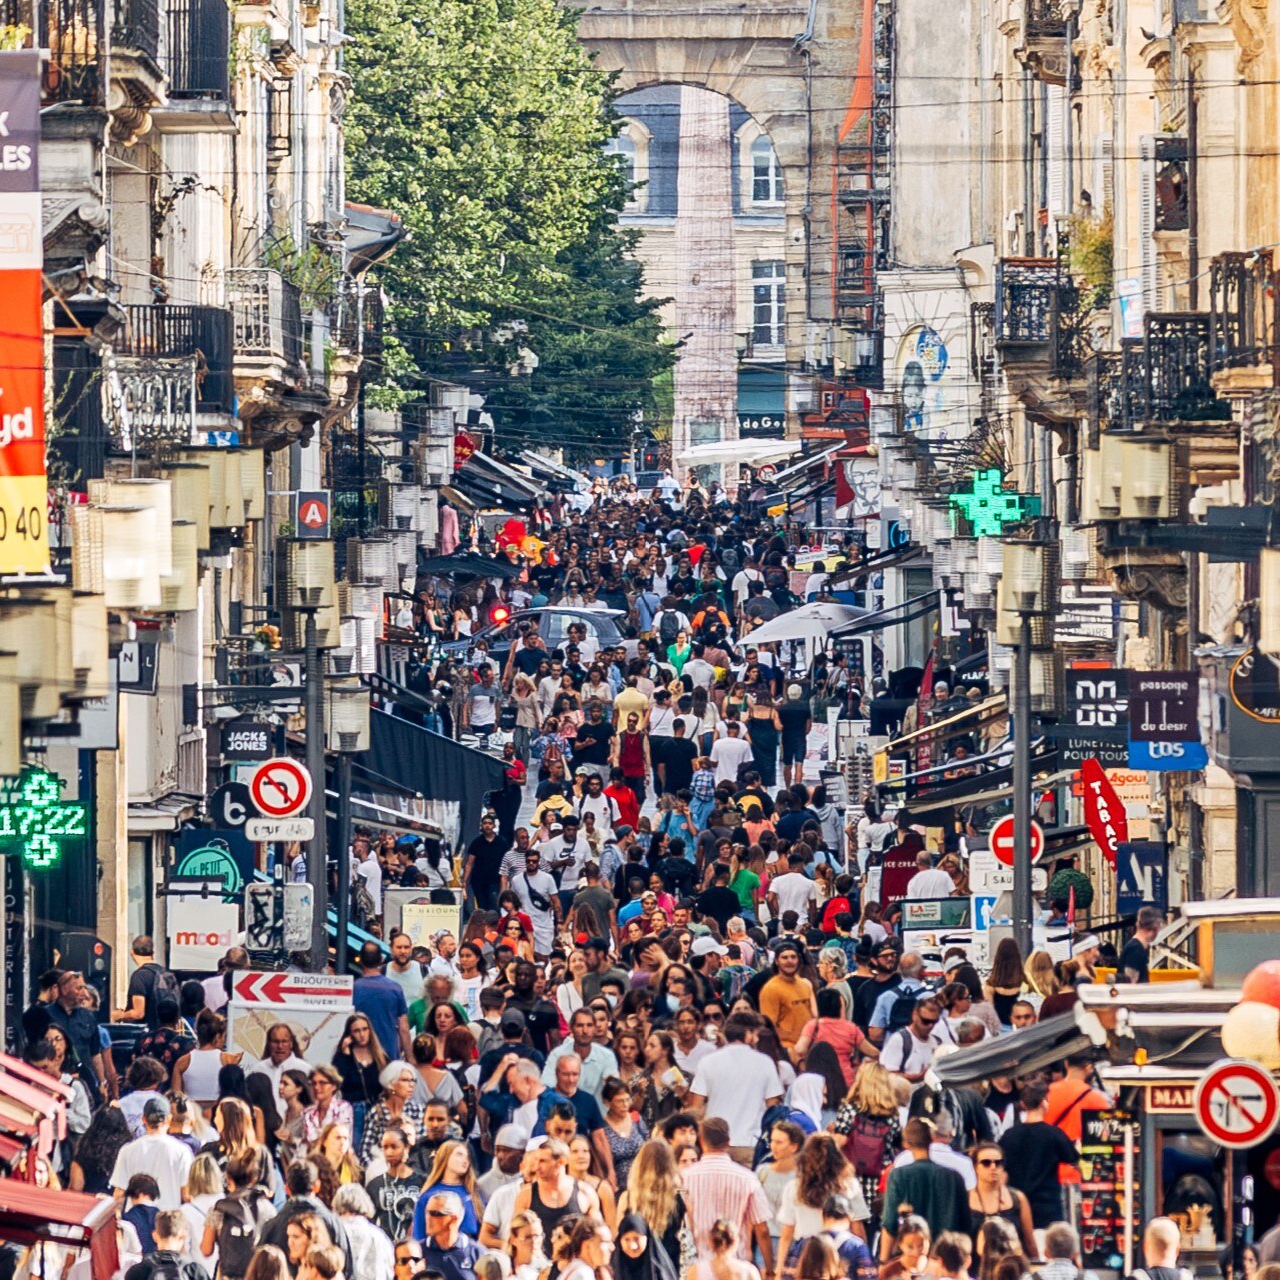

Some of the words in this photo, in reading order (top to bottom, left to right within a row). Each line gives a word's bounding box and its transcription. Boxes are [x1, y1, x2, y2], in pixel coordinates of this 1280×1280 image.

[305, 503, 322, 523] A
[15, 506, 42, 541] 40
[1140, 680, 1189, 696] passage
[1141, 722, 1157, 732] du
[227, 731, 268, 742] JACK&
[227, 740, 268, 751] JONES
[1064, 750, 1095, 761] POUR
[1100, 750, 1130, 761] TOUS
[1089, 780, 1118, 851] TABAC
[898, 860, 918, 868] CREA
[992, 875, 1013, 885] SAU
[176, 929, 232, 947] mood
[293, 975, 350, 987] BIJOUTERIE
